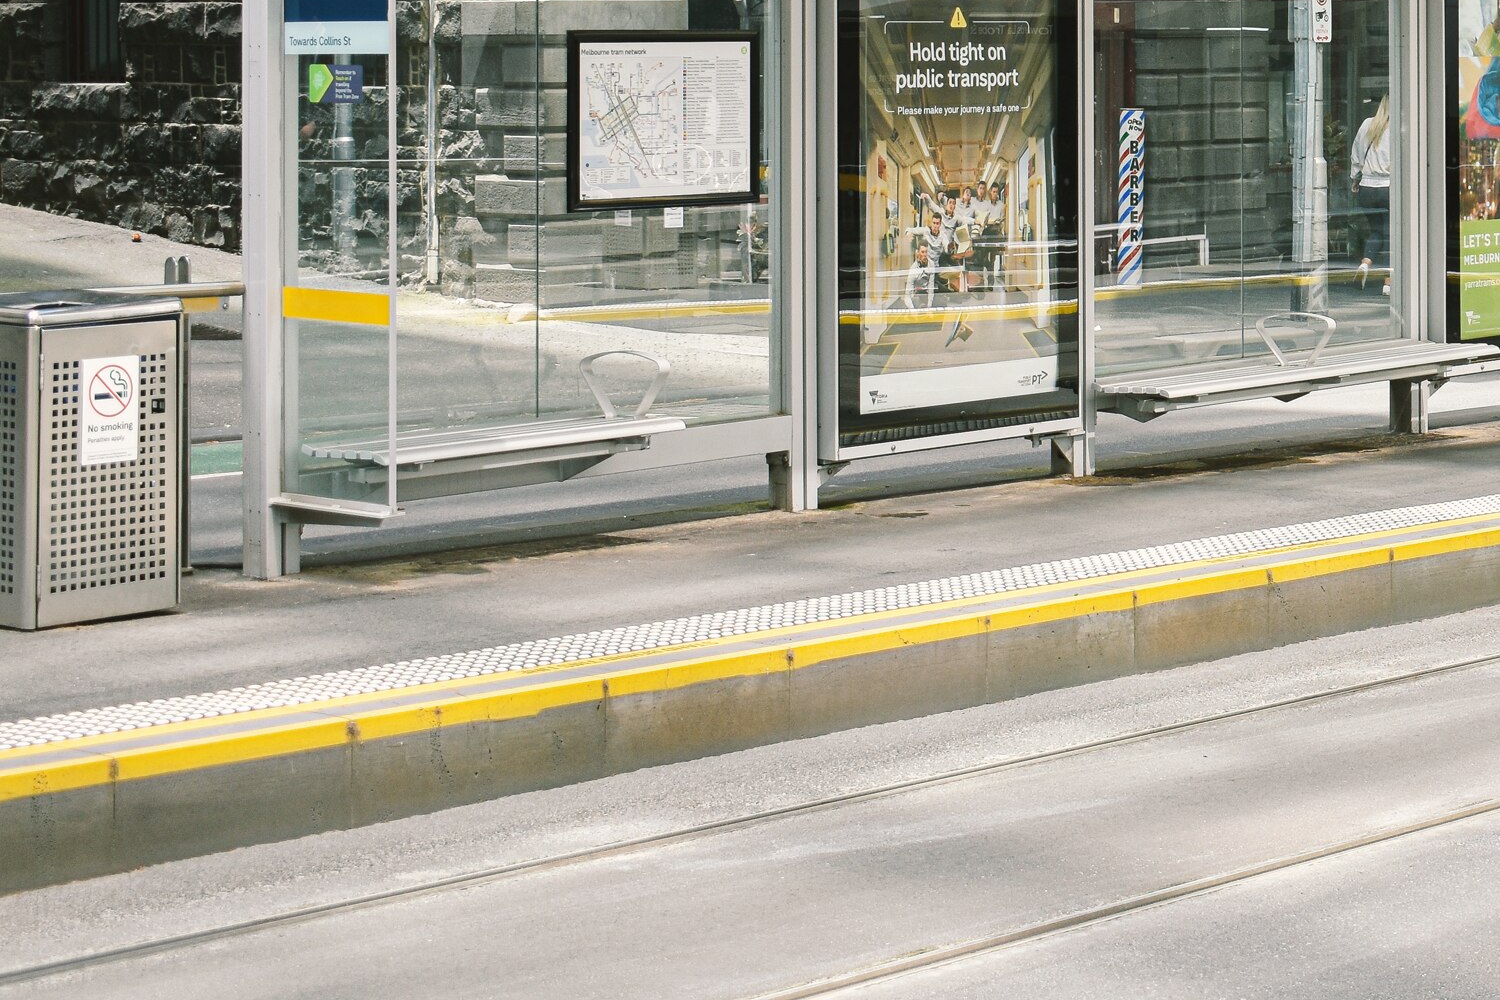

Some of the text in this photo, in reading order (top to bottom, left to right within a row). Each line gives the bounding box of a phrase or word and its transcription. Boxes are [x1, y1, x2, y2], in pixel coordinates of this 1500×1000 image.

[289, 36, 351, 46] Towards Collins St
[910, 42, 1006, 66] Hold tight on
[896, 69, 1019, 93] public transport
[897, 106, 922, 115] Please
[924, 106, 943, 115] make
[944, 106, 959, 115] your
[960, 105, 985, 115] journey
[992, 104, 1007, 112] safe
[1008, 104, 1020, 112] one
[1129, 140, 1140, 242] BARBER
[87, 421, 133, 433] No smoking
